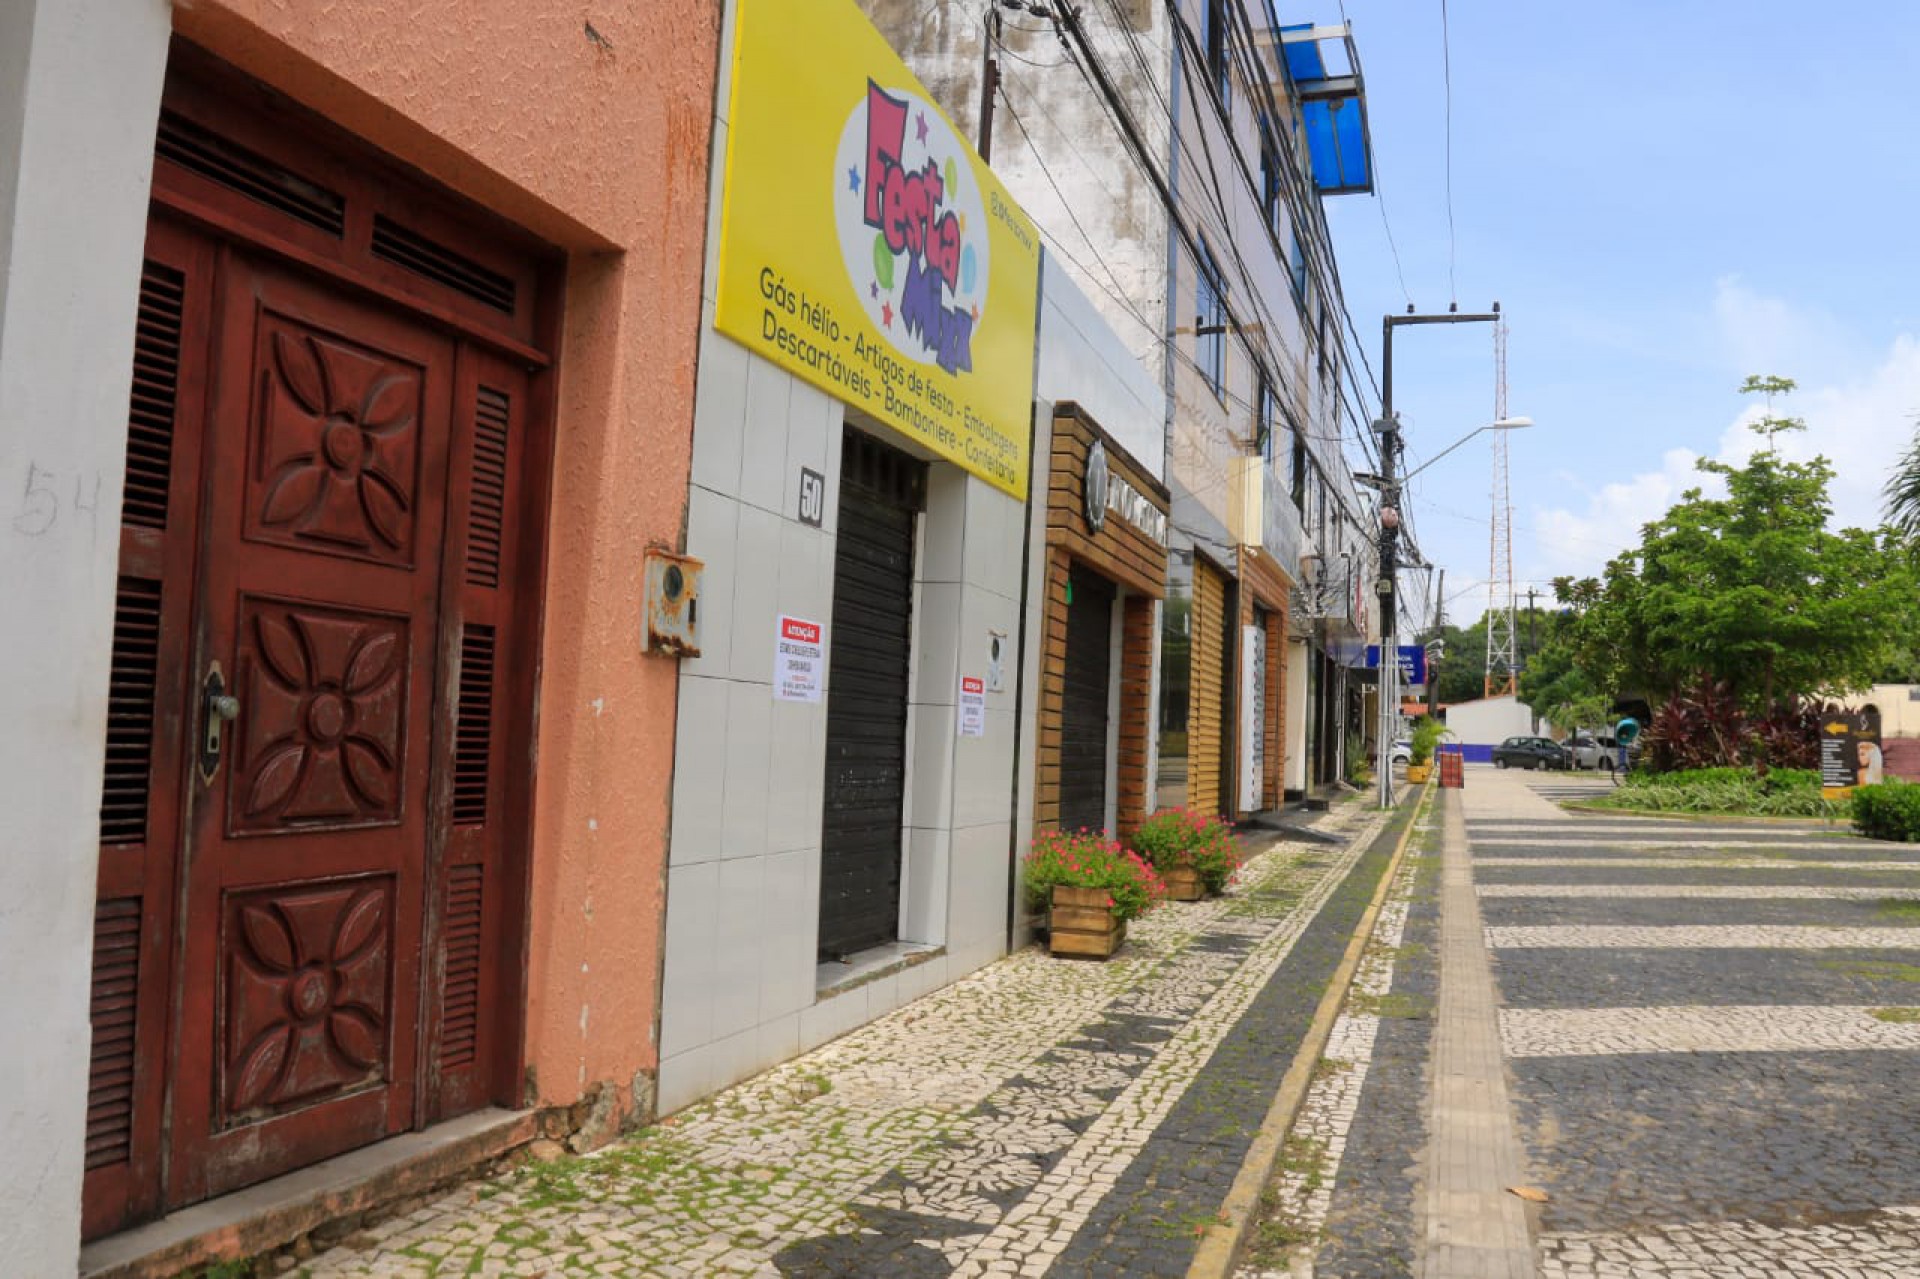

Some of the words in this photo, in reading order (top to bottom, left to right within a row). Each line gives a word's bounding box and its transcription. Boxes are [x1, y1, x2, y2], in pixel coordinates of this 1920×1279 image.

[864, 76, 960, 298] Festa
[760, 266, 795, 314] Gás
[801, 292, 839, 342] hélio
[854, 332, 904, 385] Artigos
[908, 370, 923, 397] de
[926, 378, 953, 417] festa
[964, 405, 1018, 460] Embalagens
[762, 308, 871, 399] Descartáveis
[885, 385, 956, 450] Bomboniere
[966, 437, 1015, 485] Confeitaria
[801, 473, 821, 520] 50
